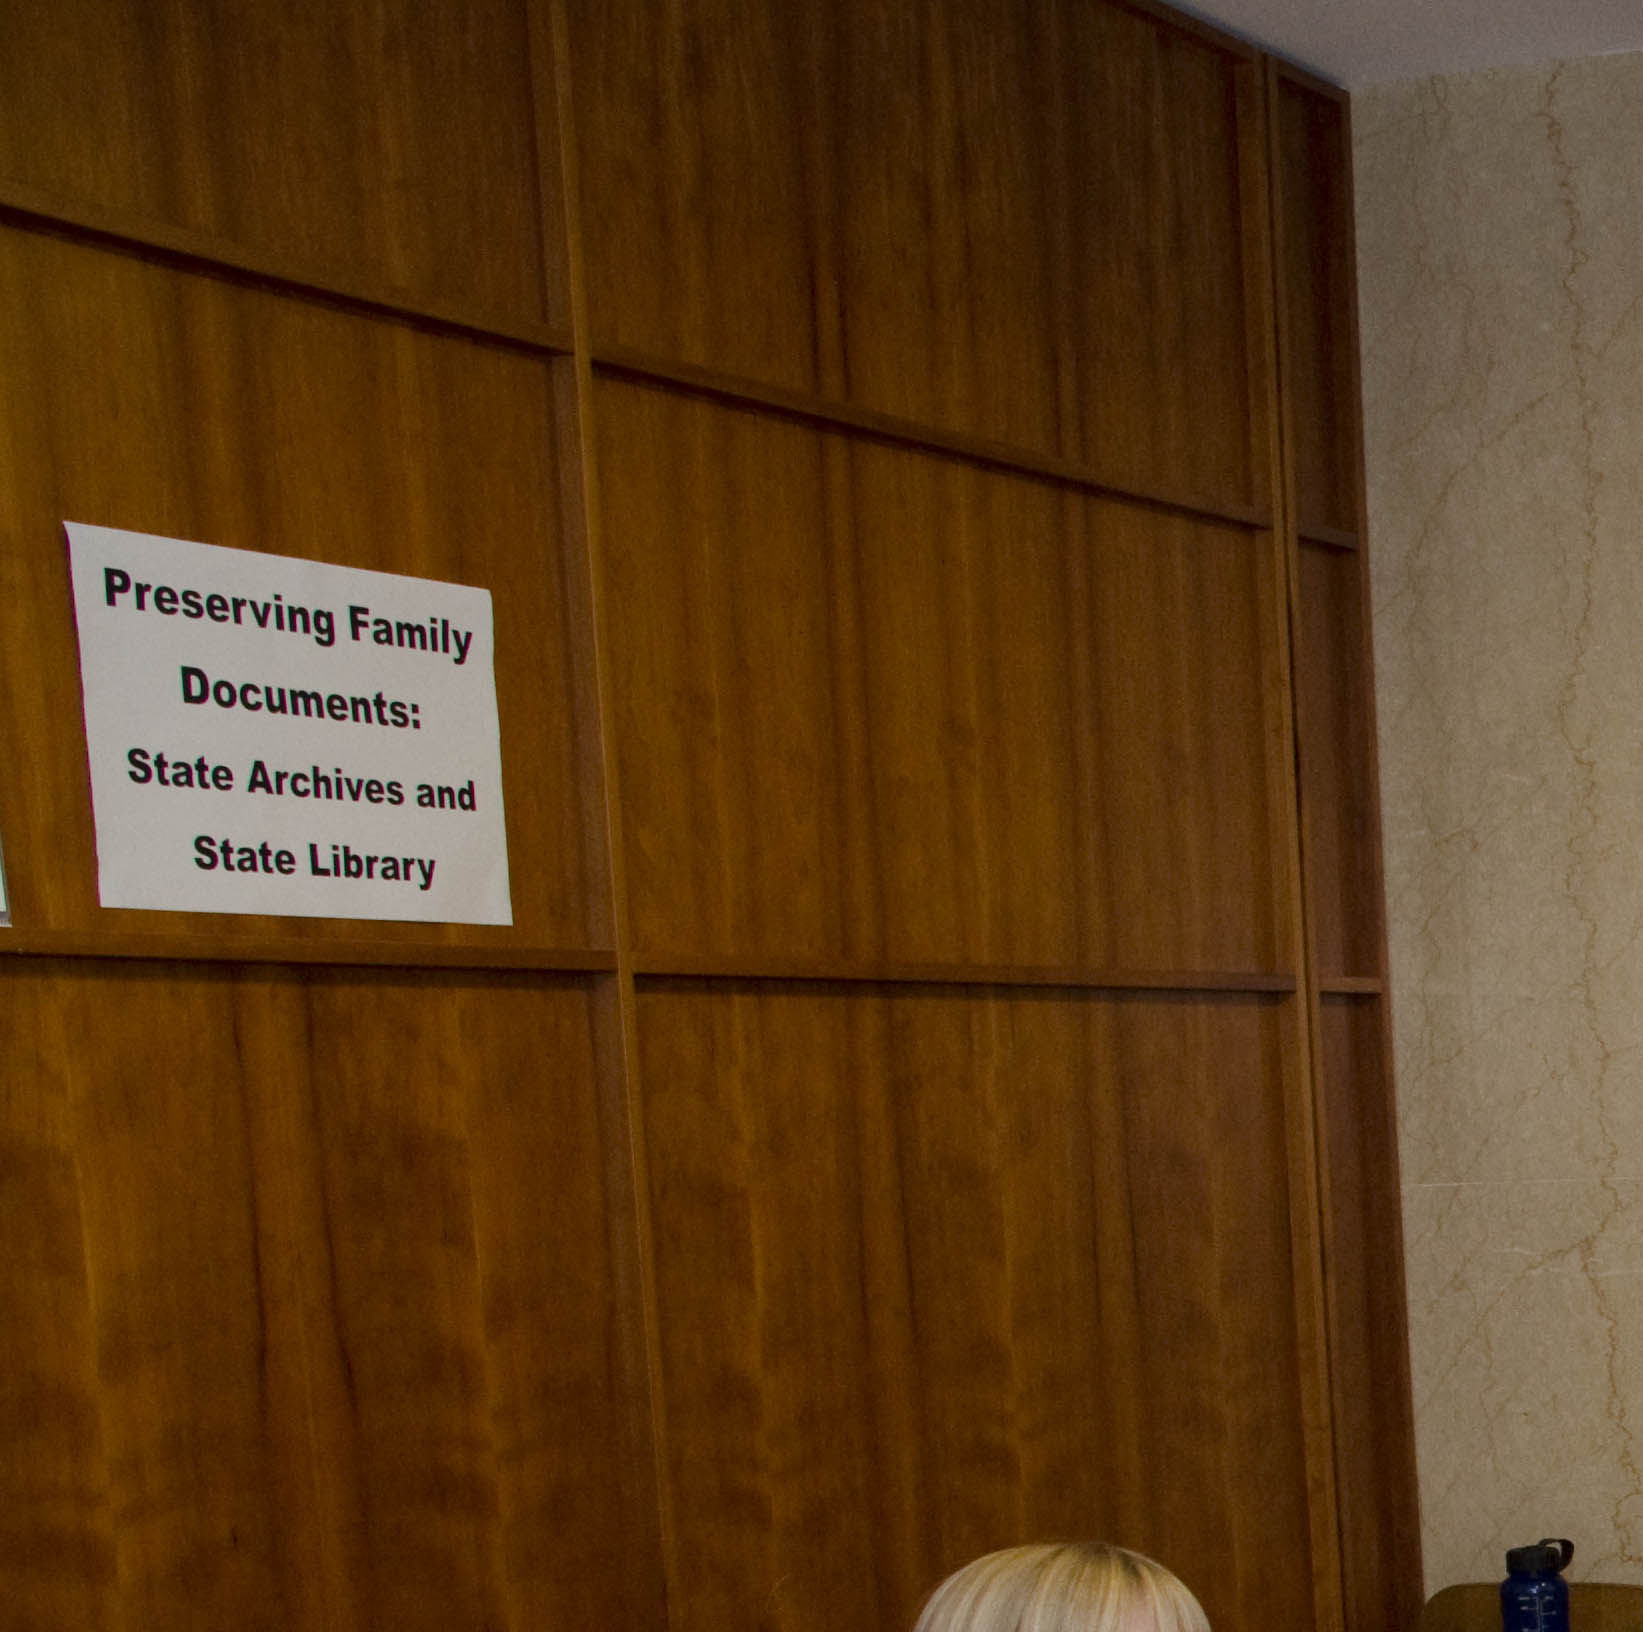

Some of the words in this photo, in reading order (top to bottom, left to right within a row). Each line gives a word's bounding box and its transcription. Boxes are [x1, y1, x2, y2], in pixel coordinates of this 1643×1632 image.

[103, 566, 336, 647] Preserving
[347, 604, 473, 665] Family
[180, 665, 422, 729] Documents:
[127, 748, 234, 792] State
[247, 760, 405, 806] Archives
[416, 781, 478, 812] and
[193, 835, 297, 876] State
[309, 843, 436, 891] Library
